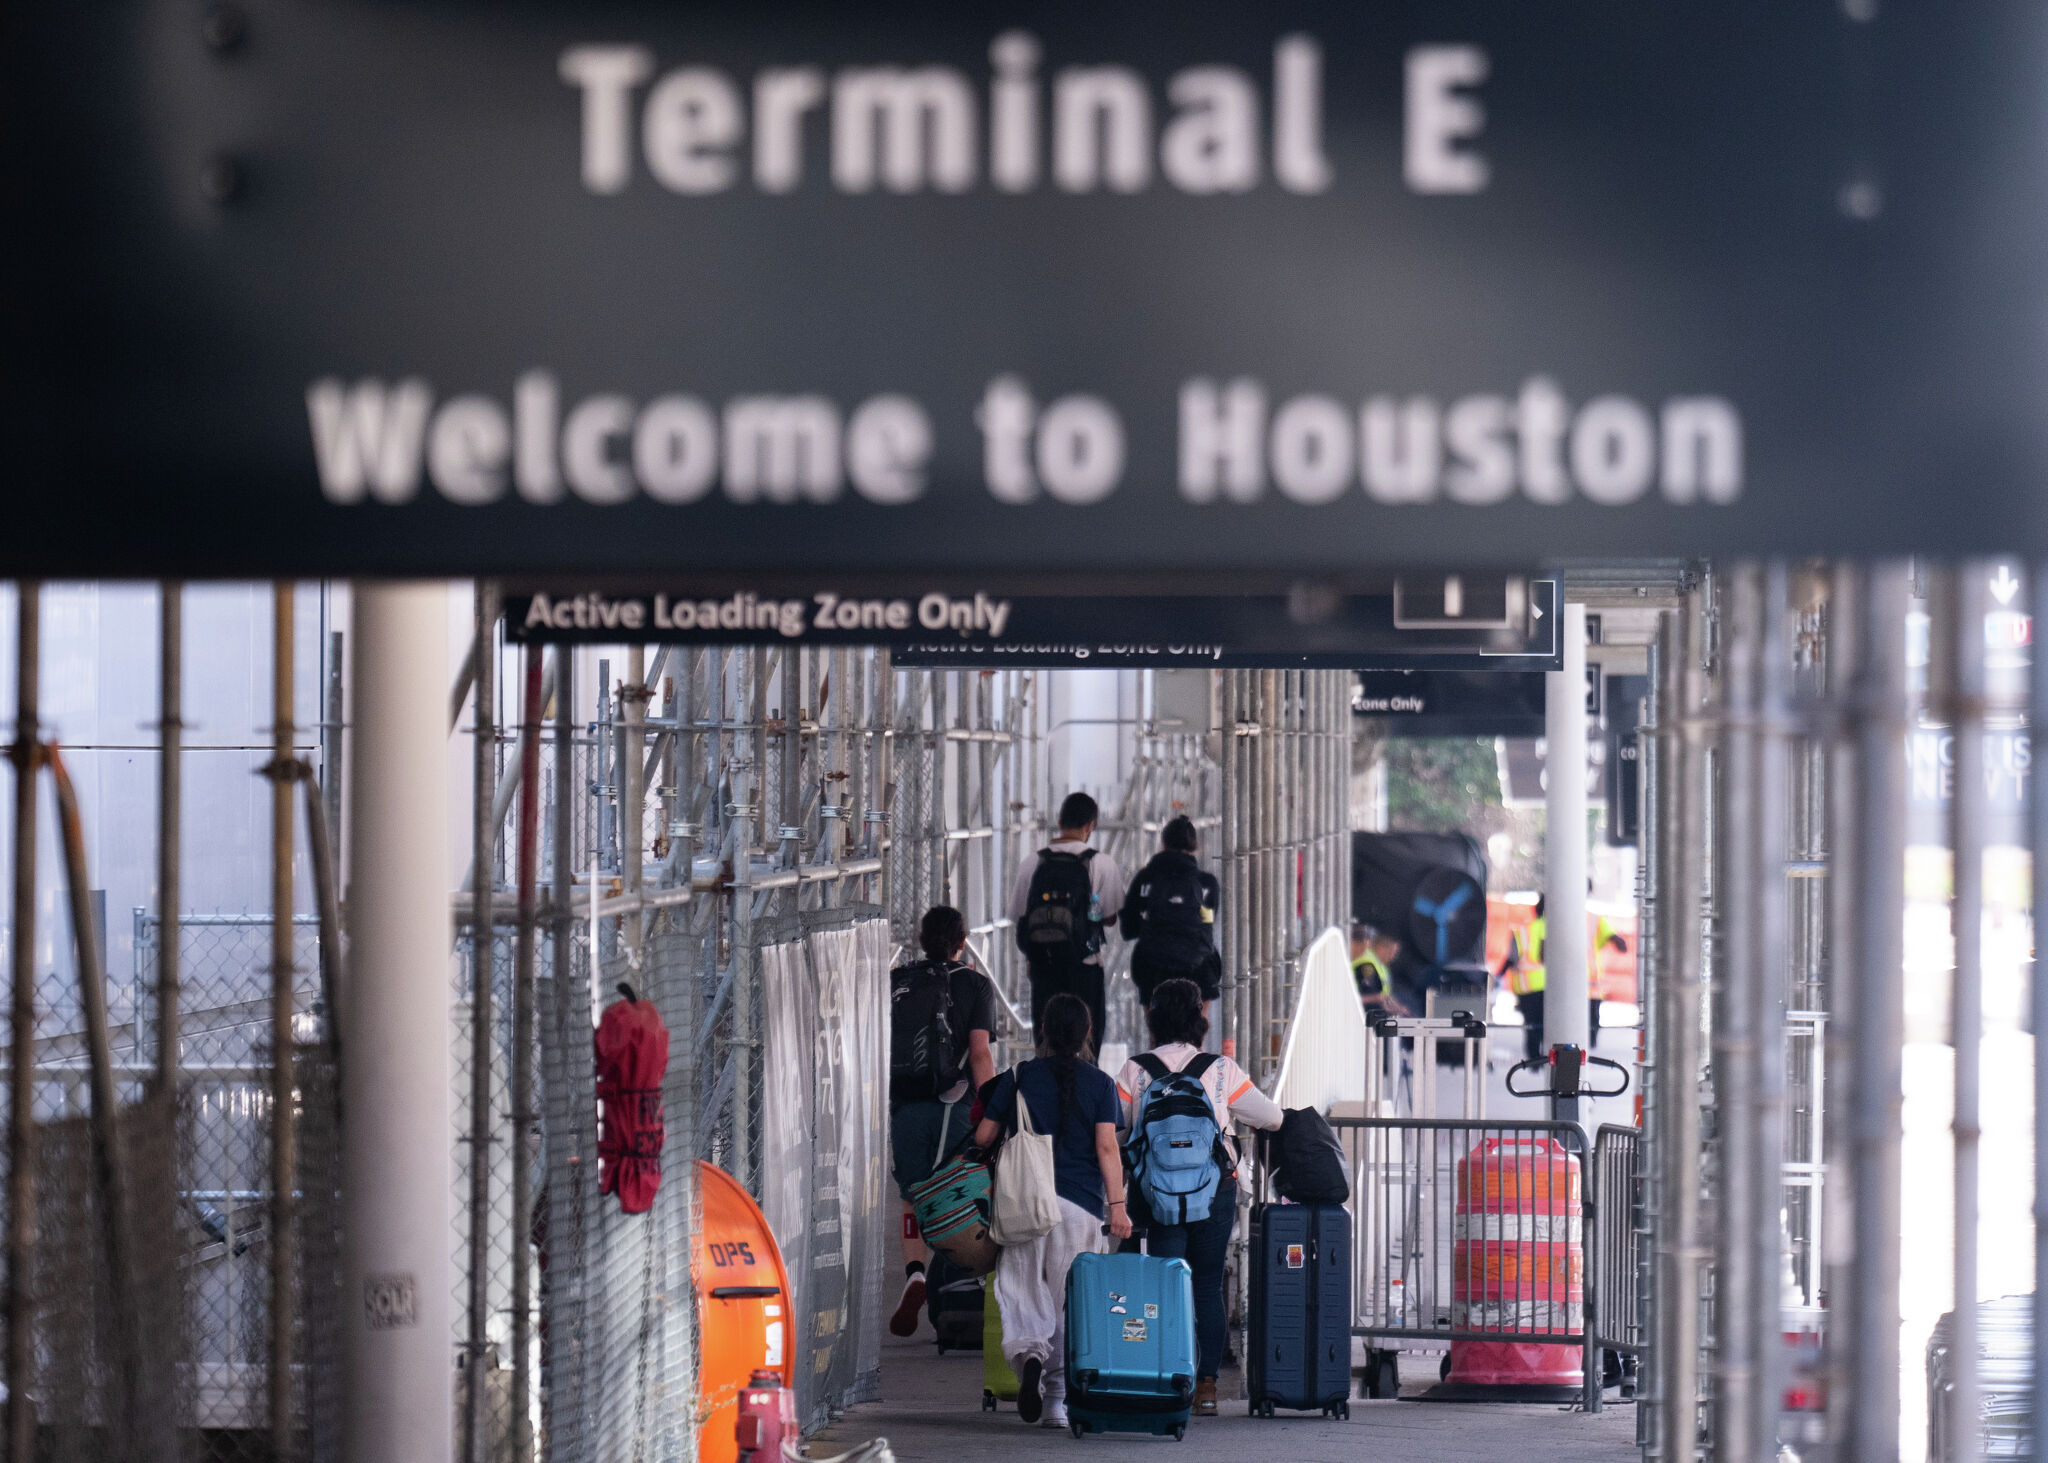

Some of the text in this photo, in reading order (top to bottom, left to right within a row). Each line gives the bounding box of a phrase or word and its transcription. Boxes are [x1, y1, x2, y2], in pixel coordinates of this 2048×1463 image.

[560, 36, 1487, 196] Terminal E
[307, 370, 1745, 506] Welcome to Houston
[525, 592, 1010, 636] Active Loading Zone Only
[1390, 695, 1425, 714] Only
